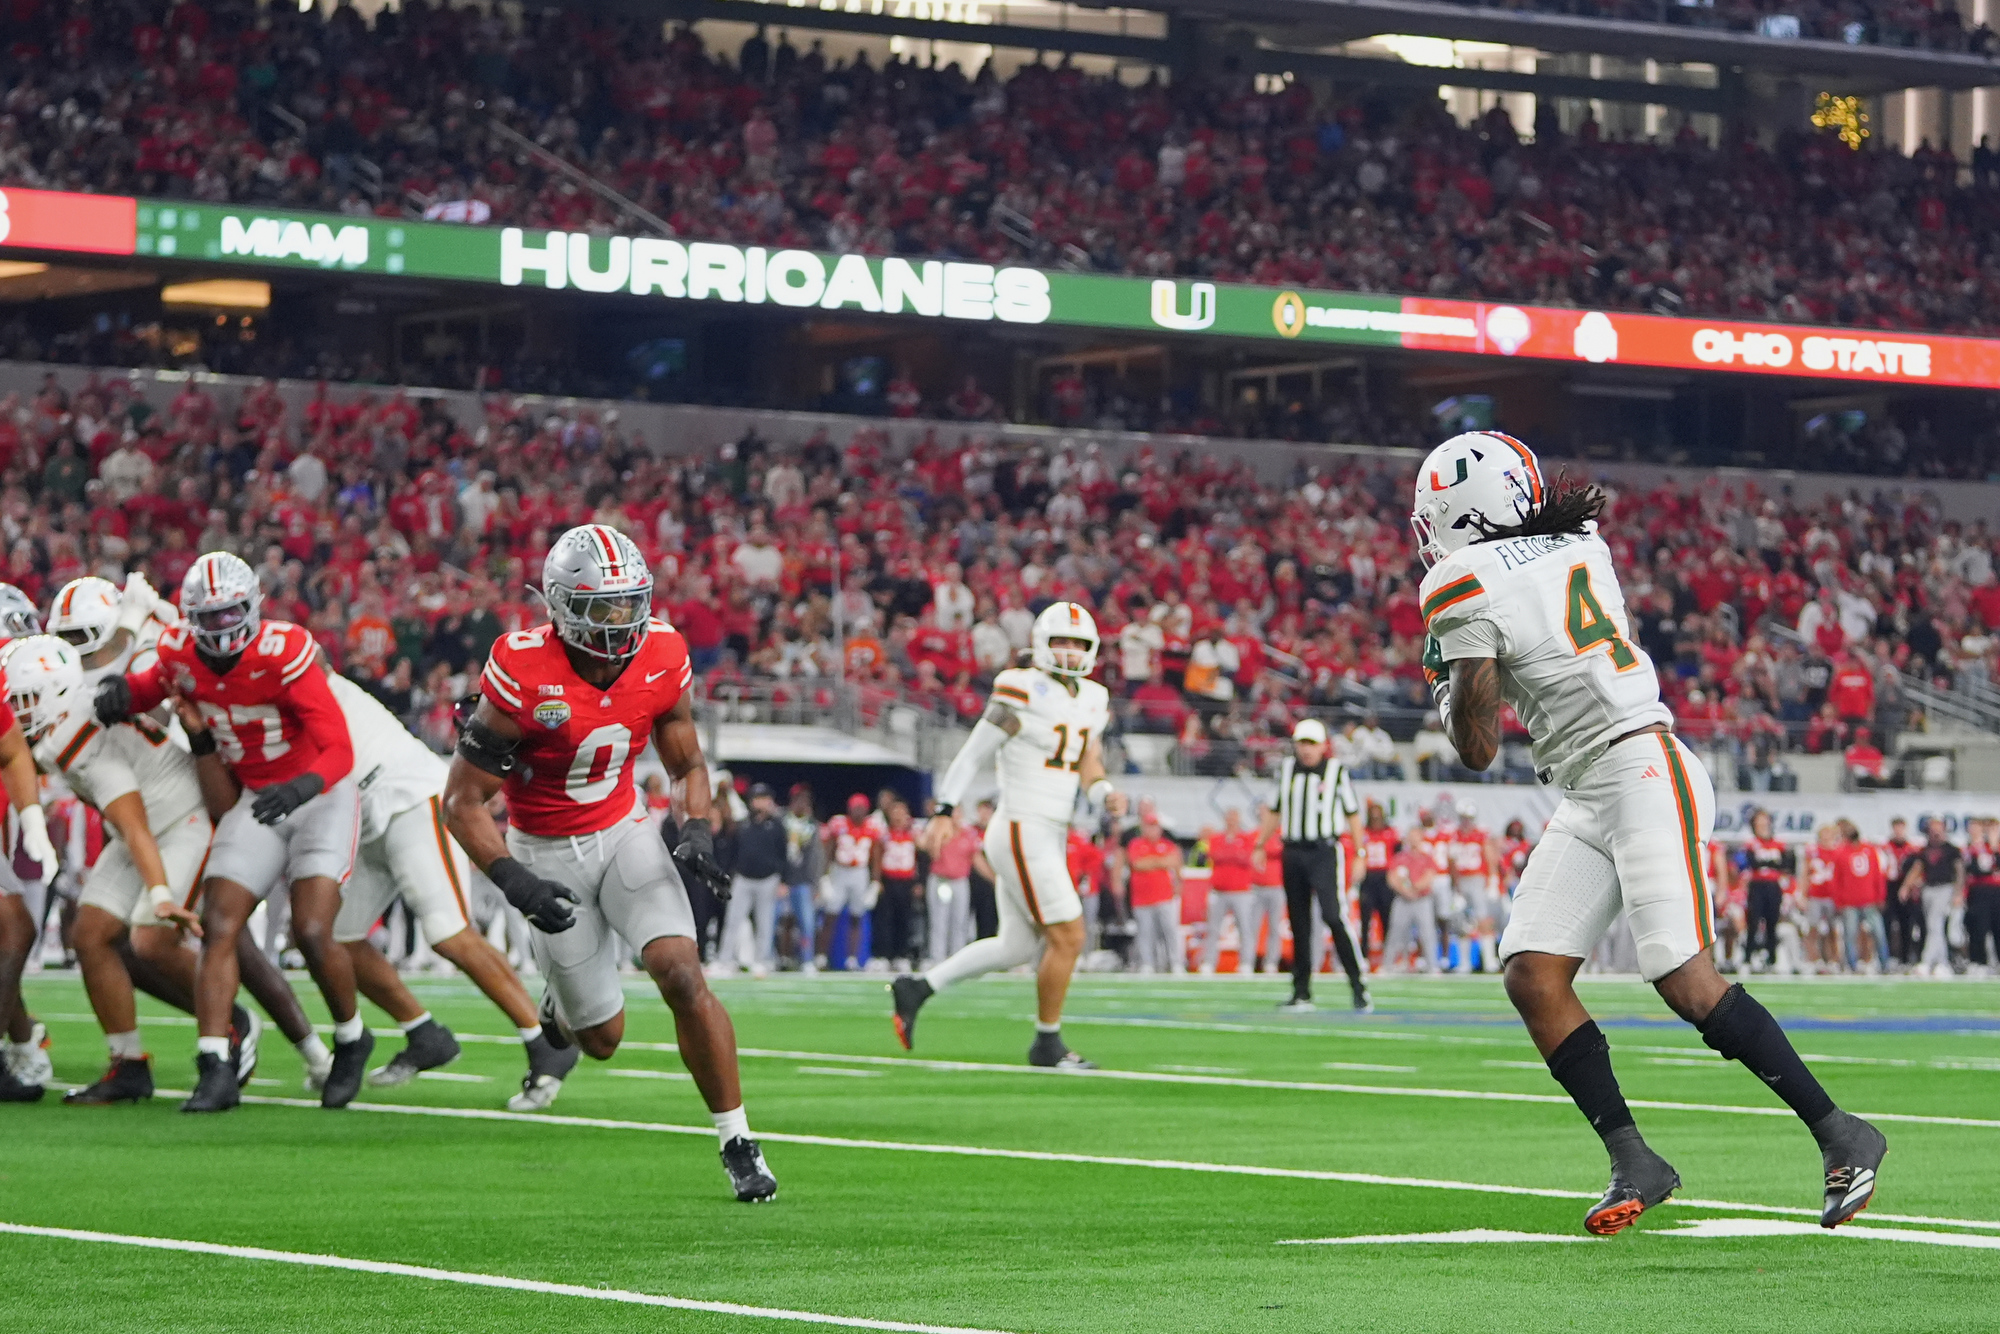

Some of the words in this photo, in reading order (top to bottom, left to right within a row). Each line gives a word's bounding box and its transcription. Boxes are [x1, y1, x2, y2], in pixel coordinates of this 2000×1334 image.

[220, 216, 368, 266] MIAMI
[501, 228, 1051, 323] HURRICANES
[1151, 280, 1215, 330] U
[1692, 328, 1792, 367] OHIO
[1801, 337, 1931, 377] STATE
[1430, 458, 1468, 492] U
[507, 631, 545, 651] 0
[1564, 562, 1639, 673] 4
[565, 723, 632, 804] 0
[1044, 723, 1091, 772] 11
